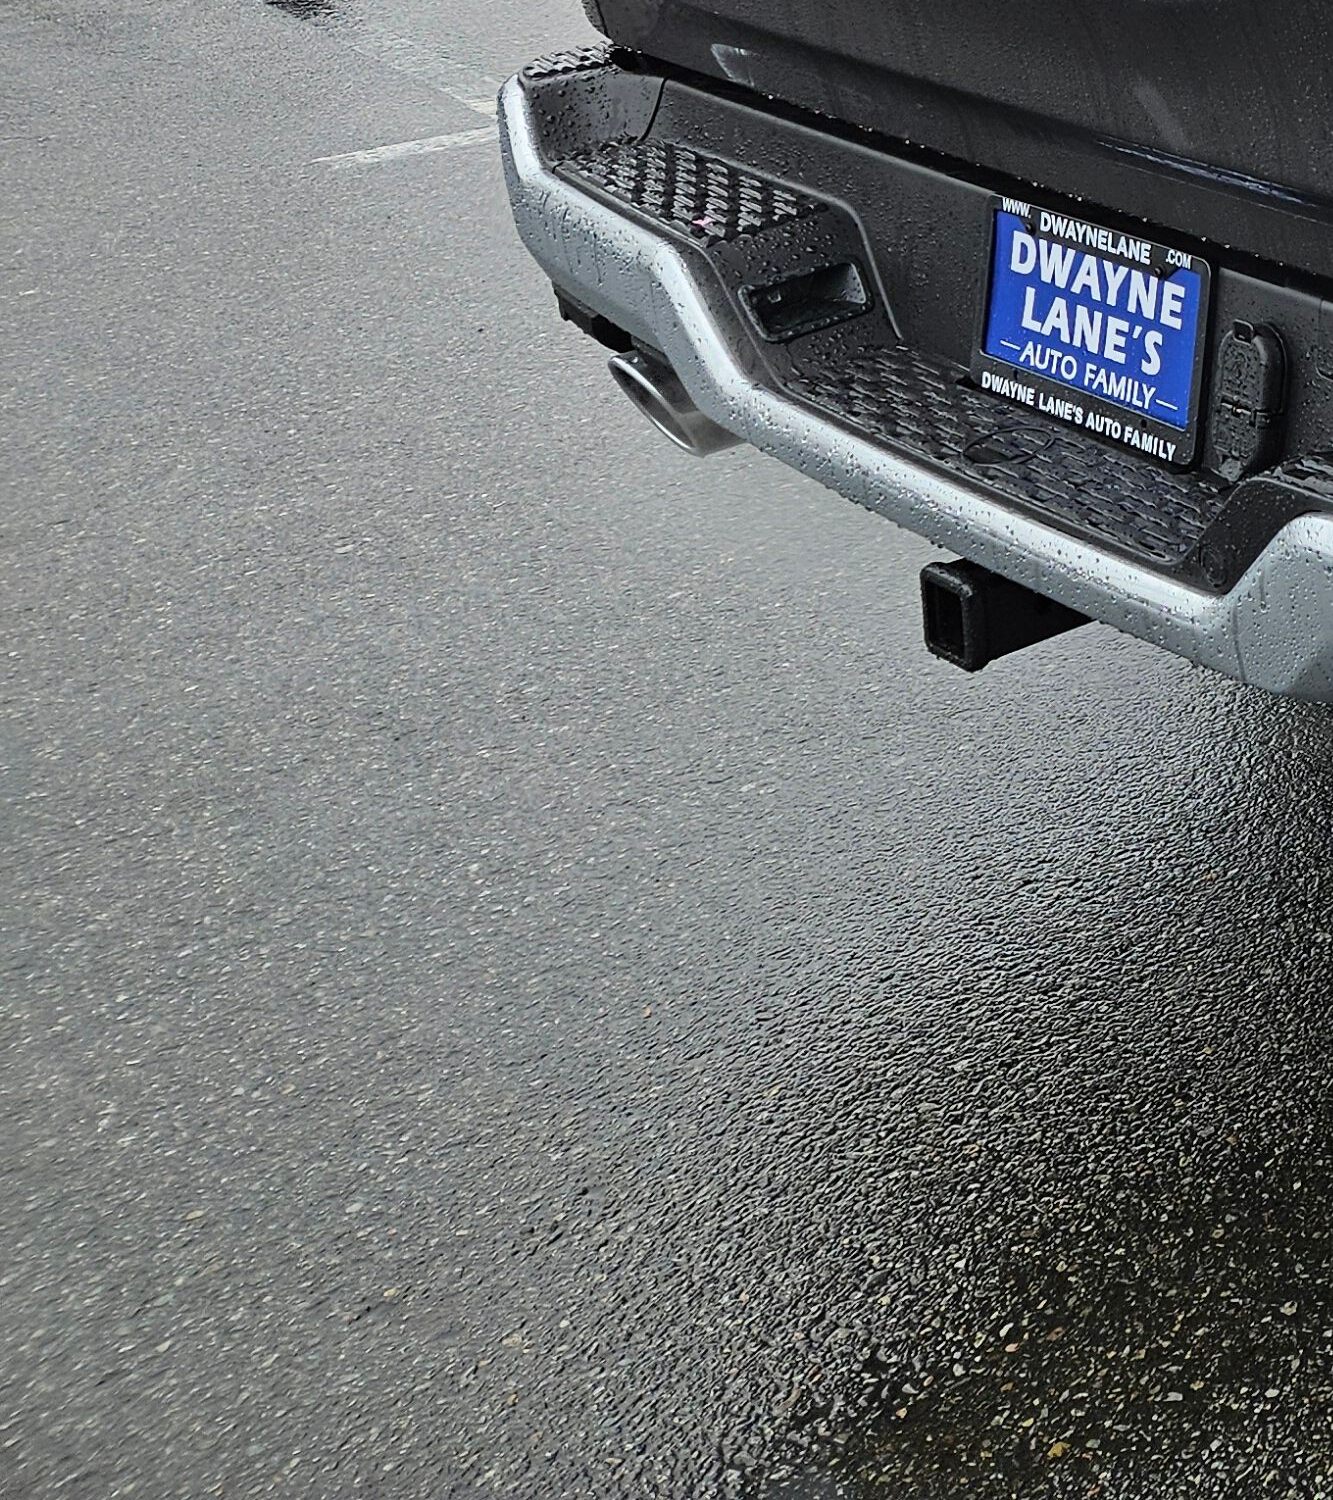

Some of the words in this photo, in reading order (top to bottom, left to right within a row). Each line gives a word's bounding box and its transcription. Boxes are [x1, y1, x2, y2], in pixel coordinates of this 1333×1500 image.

[1002, 197, 1031, 218] WWW.
[1040, 211, 1152, 266] DWAYNELANE
[1165, 249, 1192, 269] .COM
[1010, 230, 1186, 330] DWAYNE
[1019, 341, 1077, 380] AUTO
[1084, 362, 1156, 410] FAMILY
[1021, 287, 1163, 376] LANE'S
[981, 371, 1035, 406] DWAYNE
[1039, 392, 1083, 425] LANE'S
[1085, 412, 1122, 439] AUTO
[1123, 426, 1177, 462] FAMILY
